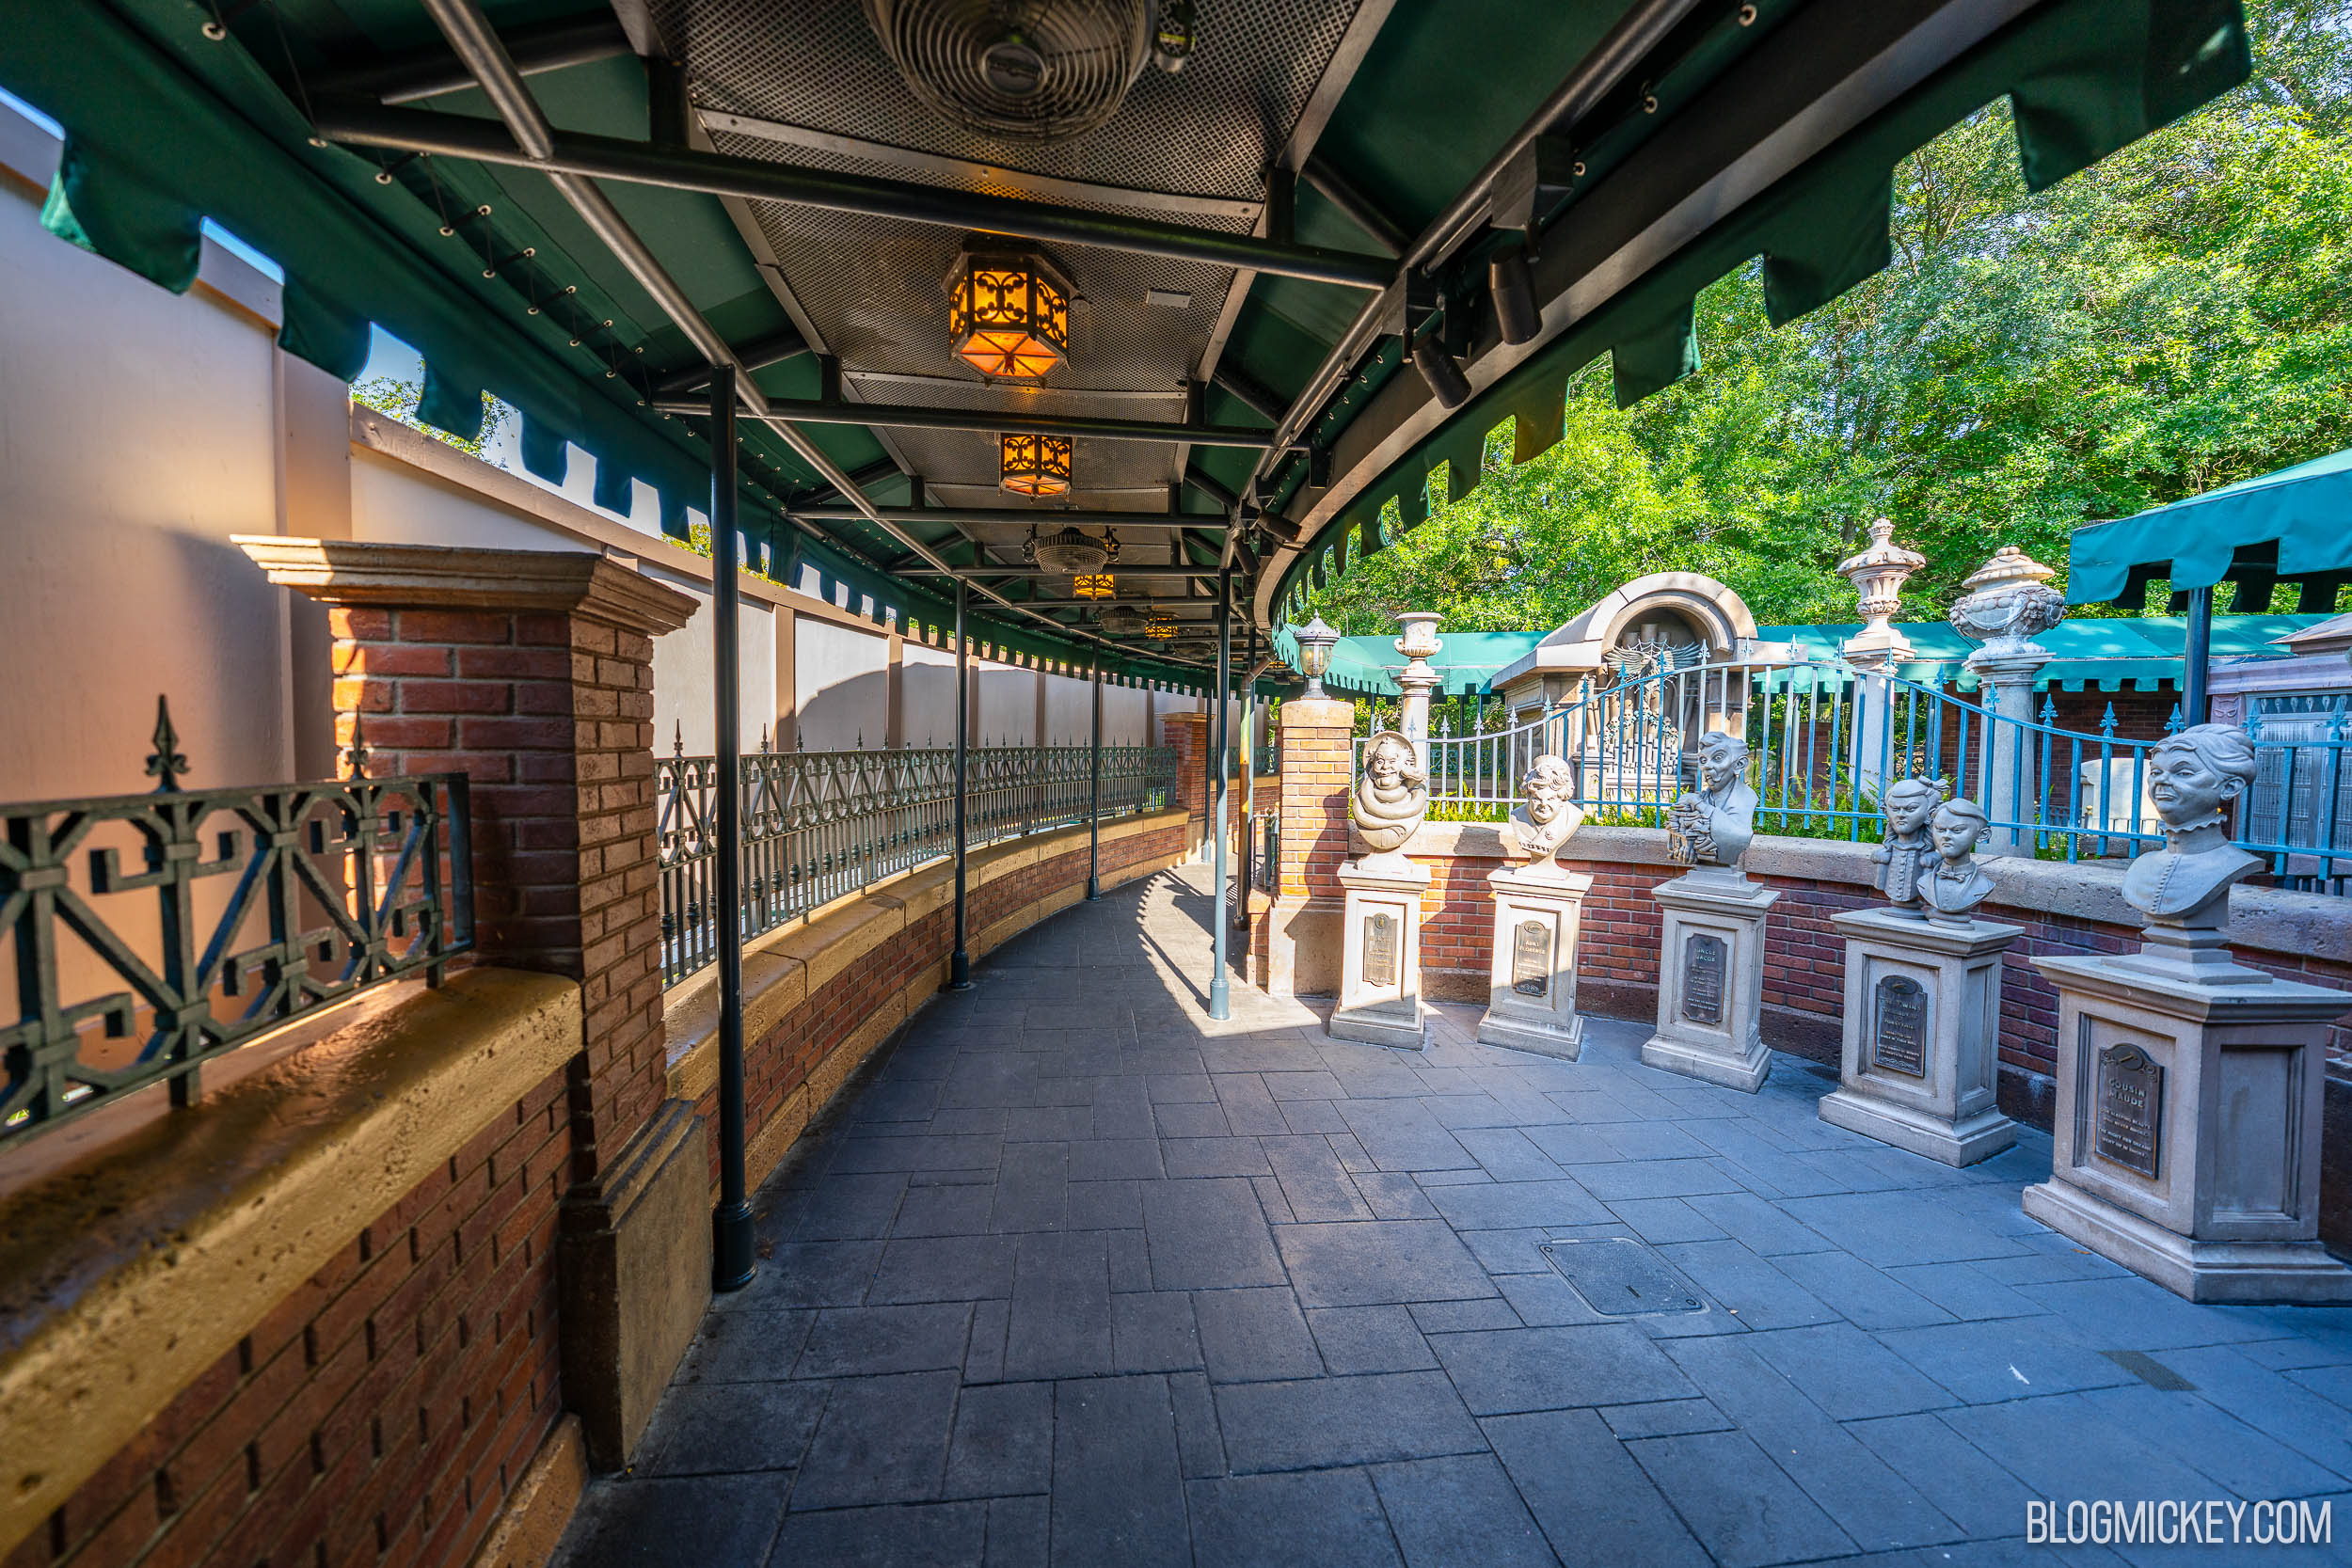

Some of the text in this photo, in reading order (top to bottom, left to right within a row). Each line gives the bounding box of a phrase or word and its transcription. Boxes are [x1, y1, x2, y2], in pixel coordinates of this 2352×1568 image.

[1693, 947, 1716, 956] UNCLE
[2108, 1078, 2145, 1097] COUSIN
[2108, 1090, 2145, 1108] MAUDE
